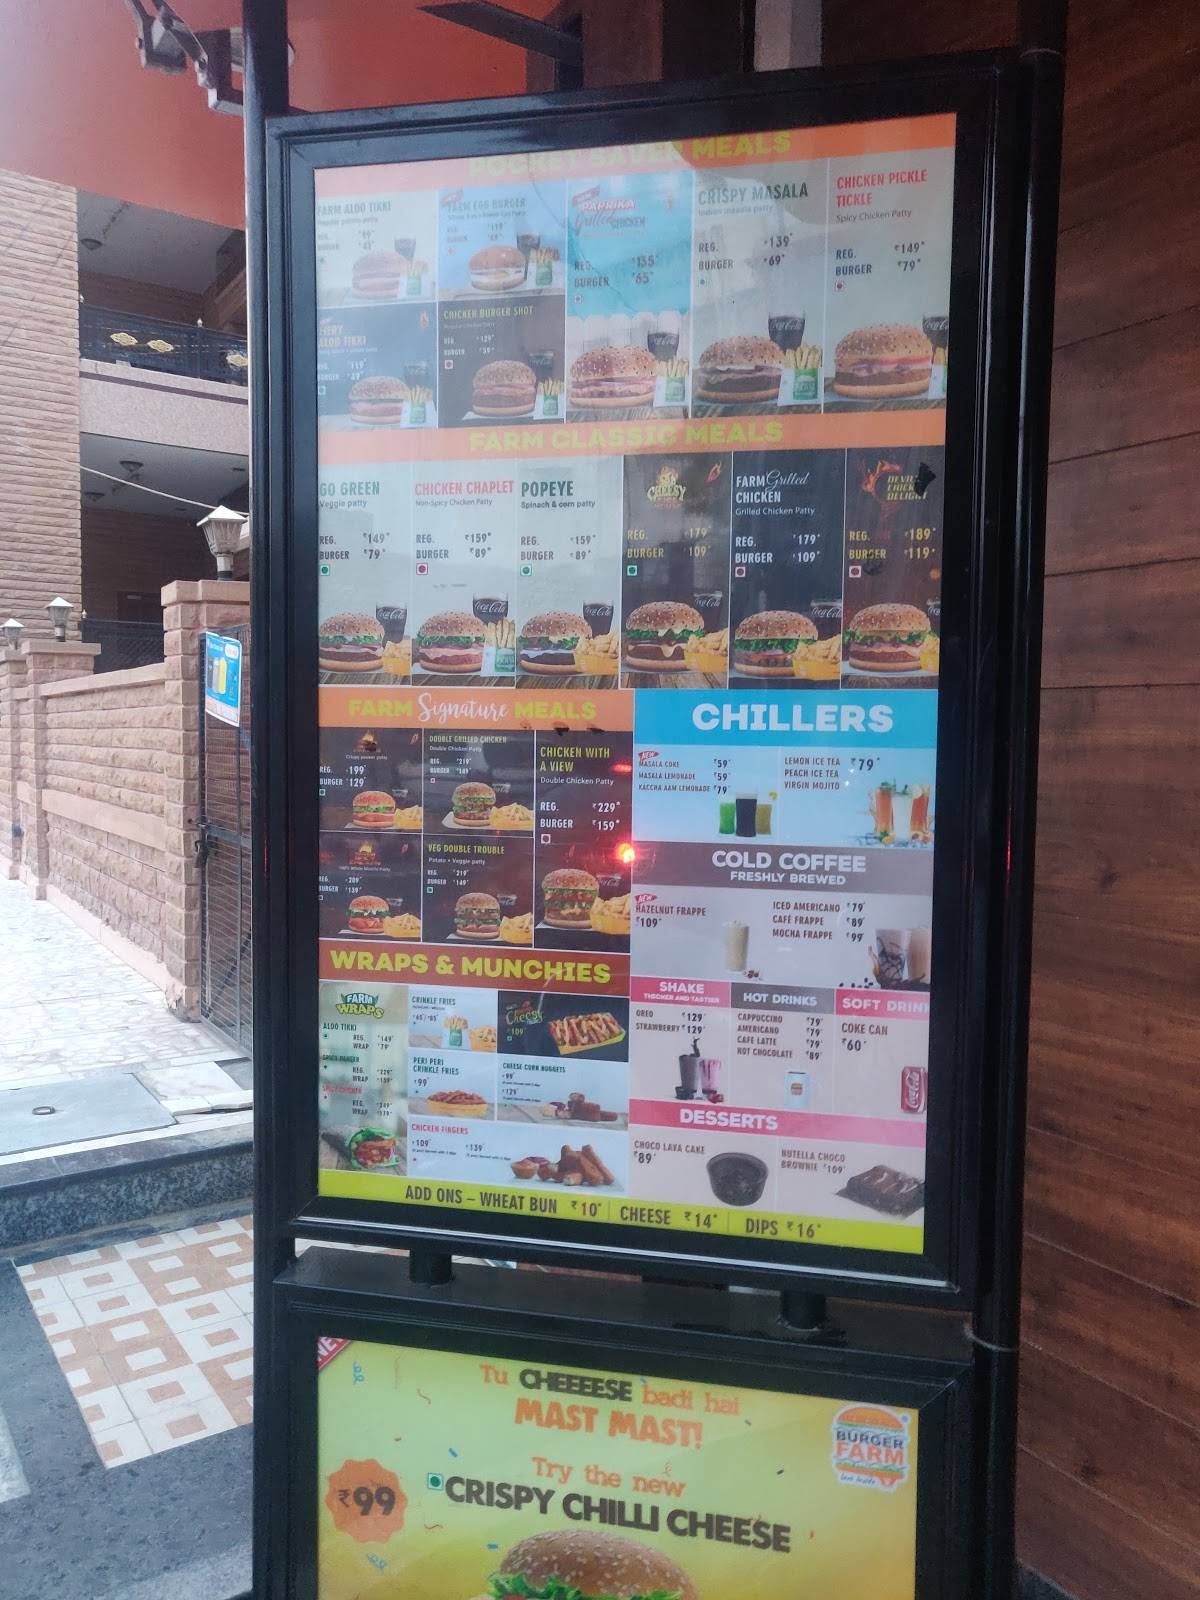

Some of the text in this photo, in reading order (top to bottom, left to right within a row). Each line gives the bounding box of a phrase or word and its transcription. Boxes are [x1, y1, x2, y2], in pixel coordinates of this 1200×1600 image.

[692, 130, 792, 159] MEALS
[837, 169, 929, 190] CHICKEN PICKLE
[752, 182, 808, 200] MASALA
[859, 210, 890, 220] Chicken
[892, 208, 912, 218] Patty
[836, 249, 857, 260] REG.
[698, 258, 734, 271] BURGER
[835, 263, 873, 276] BURGER
[513, 305, 535, 316] SHOT
[471, 420, 784, 450] FARM CLASSIC MEALS
[736, 475, 765, 488] FARM
[320, 481, 381, 496] GO GREEN
[414, 480, 514, 496] CHICKEN CHAPLET
[521, 480, 574, 498] POPEYE
[347, 499, 368, 508] patty
[449, 498, 476, 507] Chicken
[736, 491, 781, 504] CHICKEN
[521, 501, 550, 510] Spinach
[551, 501, 557, 509] &
[576, 500, 596, 509] patty
[762, 507, 793, 516] Chicken
[795, 506, 815, 516] Patty
[319, 535, 336, 544] REG.
[416, 534, 434, 544] REG.
[520, 535, 540, 546] REG.
[627, 528, 648, 541] REG.
[849, 530, 871, 541] REG.
[735, 536, 757, 547] REG.
[319, 550, 350, 560] BURGER
[416, 549, 449, 559] BURGER
[520, 550, 554, 561] BURGER
[627, 546, 664, 559] BURGER
[735, 552, 773, 563] BURGER
[849, 549, 886, 560] BURGER
[349, 692, 597, 723] FARM Signature MEALS
[692, 702, 894, 733] CHILLERS
[540, 746, 610, 759] CHICKEN WITH
[540, 761, 575, 773] A VIEW
[784, 757, 841, 766] LEMON ICE TEA
[784, 769, 839, 778] PEACH ICE TEA
[319, 778, 343, 787] BURGER
[540, 776, 614, 787] Double Chicken Patty
[784, 781, 840, 791] VIRGIN MOJITO
[663, 784, 677, 792] AAM
[540, 801, 559, 812] REG.
[540, 818, 573, 829] BURGER
[428, 843, 505, 855] VEG DOUBLE TROUBLE
[712, 850, 867, 873] COLD COFFEE
[730, 870, 847, 886] FRESHLY BREWED
[635, 904, 707, 917] HAZELNUT FRAPPE
[772, 901, 841, 913] ICED AMERICANO
[794, 915, 825, 926] FRAPPE
[772, 928, 833, 941] MOCHA FRAPPE
[330, 949, 611, 984] WRAPS & MUNCHIES
[659, 981, 705, 995] SHAKE
[346, 992, 373, 1004] FARM
[412, 995, 456, 1006] CRINKLE FRIES
[743, 992, 818, 1007] HOT DRINKS
[842, 997, 881, 1010] SOFT
[336, 1003, 385, 1020] WRAPS
[341, 1023, 357, 1032] TIKKI
[737, 1024, 779, 1035] AMERICANO
[841, 1022, 888, 1037] COKE CAN
[757, 1037, 777, 1047] LATTE
[736, 1047, 793, 1060] HOT CHOCOLATE
[413, 1056, 444, 1066] PERI PERI
[413, 1065, 459, 1076] CRINKLE FRIES
[353, 1075, 369, 1083] WRAP
[679, 1108, 779, 1131] DESSERTS
[411, 1123, 441, 1134] CHICKEN
[634, 1140, 661, 1151] CHOCO
[662, 1142, 683, 1153] LAVA
[817, 1153, 846, 1163] CHOCO
[405, 1185, 557, 1214] ADD ONS WHEAT BUN
[620, 1205, 672, 1225] CHEESE
[745, 1217, 778, 1236] DIPS
[480, 1363, 510, 1386] Tu
[642, 1383, 694, 1411] badi
[703, 1391, 741, 1416] hai
[514, 1397, 704, 1449] MAST MAST!
[835, 1429, 905, 1450] BURGER
[834, 1442, 905, 1466] FARM
[531, 1456, 687, 1499] Try the new
[444, 1475, 792, 1553] CRISPY CHILLI CHEESE
